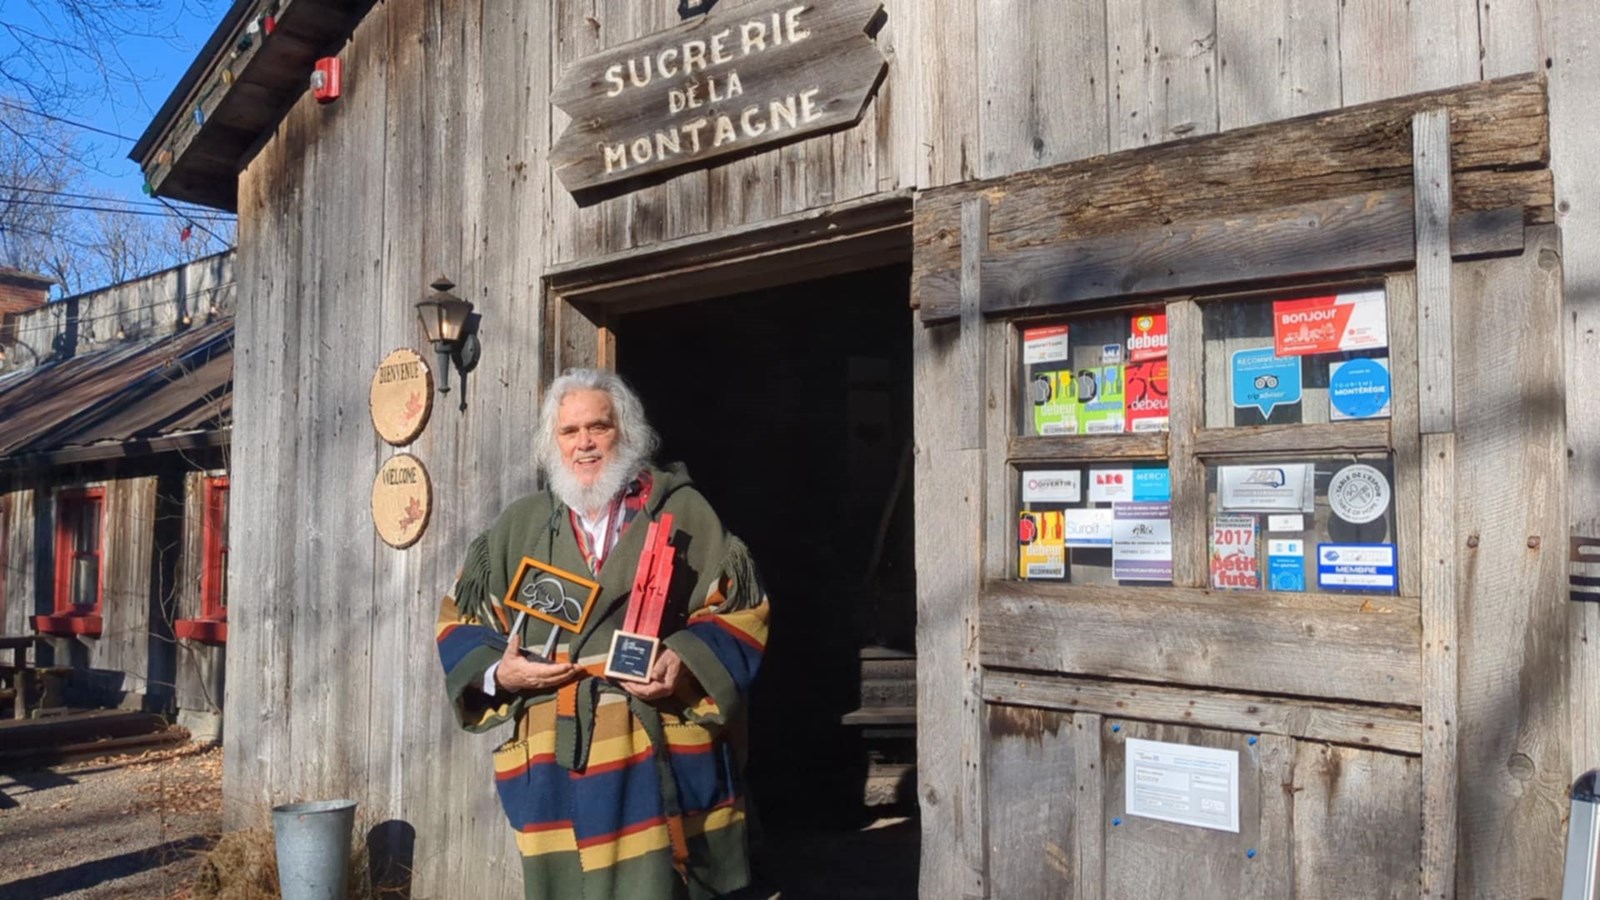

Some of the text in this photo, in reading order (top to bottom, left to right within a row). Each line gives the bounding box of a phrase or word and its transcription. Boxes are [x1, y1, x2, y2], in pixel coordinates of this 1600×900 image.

[605, 6, 811, 98] SUCRERIE
[668, 71, 744, 114] DE LA
[603, 88, 824, 174] MONTAGNE
[1127, 332, 1168, 350] debeu
[379, 361, 420, 384] BIENVENUE
[1334, 385, 1386, 396] MONTÉRÉGIE
[1131, 394, 1168, 411] debeu
[382, 467, 417, 485] WELCOME
[1215, 529, 1253, 546] 2017
[1335, 566, 1377, 574] MEMBRE
